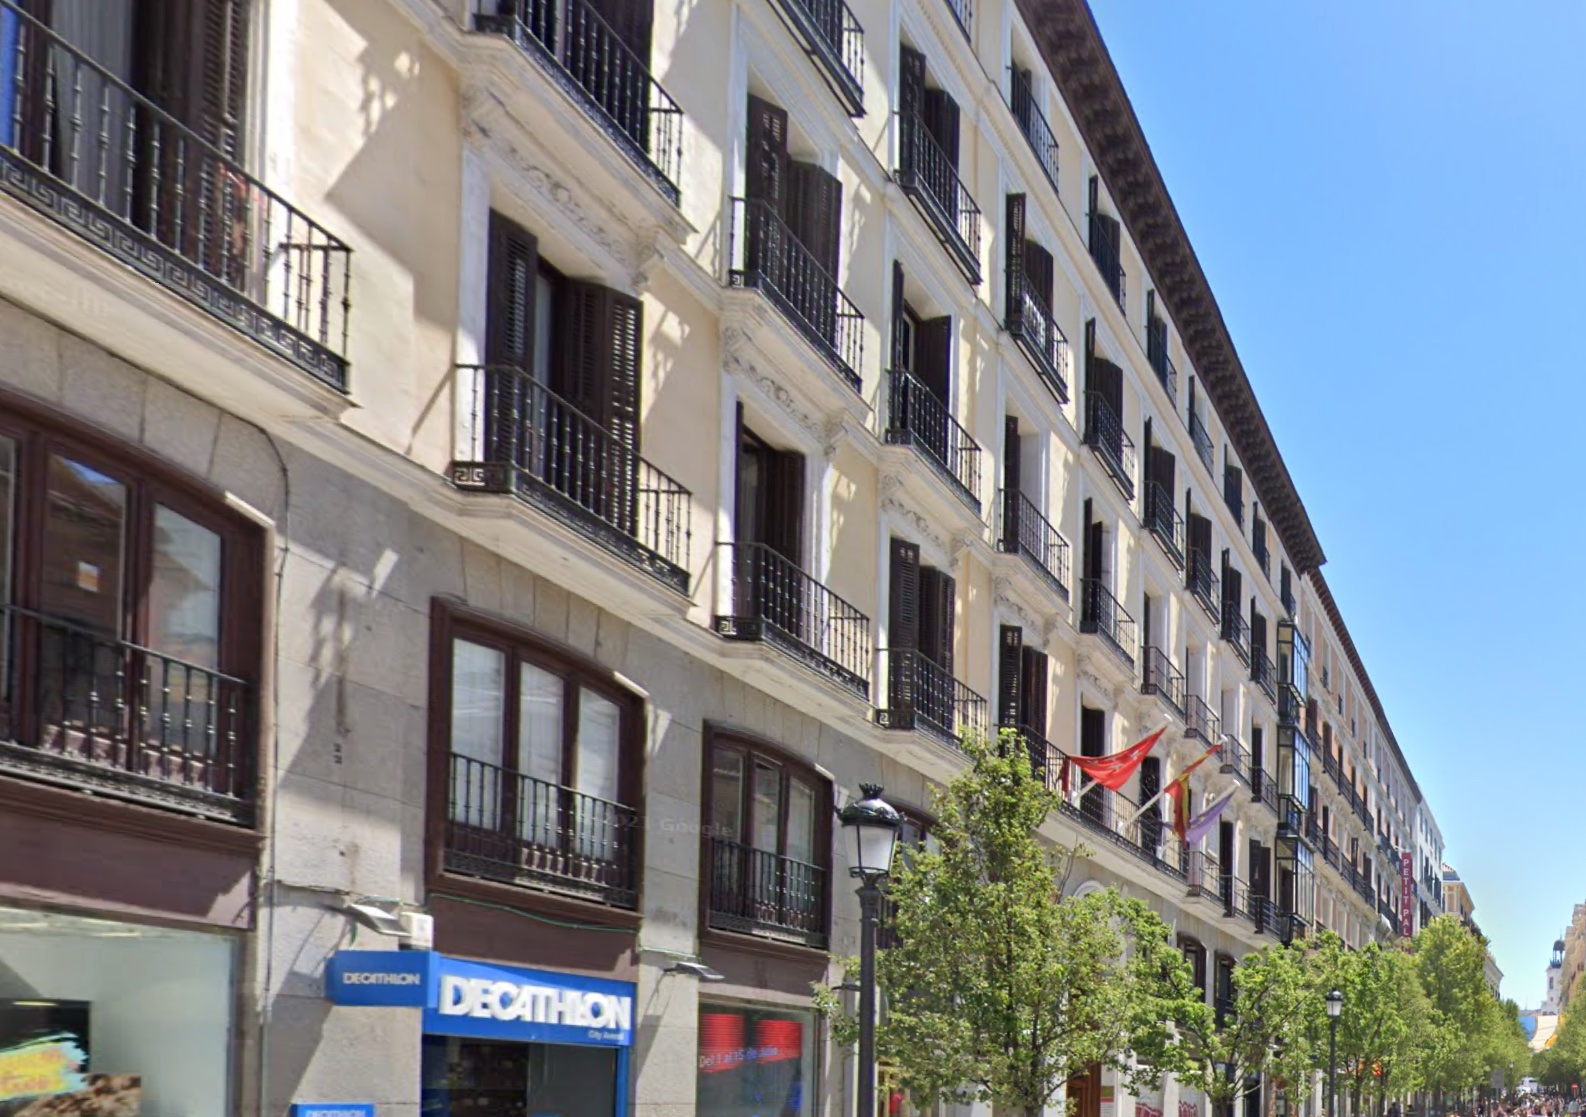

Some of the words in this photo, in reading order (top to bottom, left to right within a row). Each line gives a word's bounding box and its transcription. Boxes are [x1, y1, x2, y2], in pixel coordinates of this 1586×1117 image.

[1402, 859, 1410, 904] PETIT
[342, 971, 420, 986] DECATHLON
[438, 974, 632, 1031] DECATHLON
